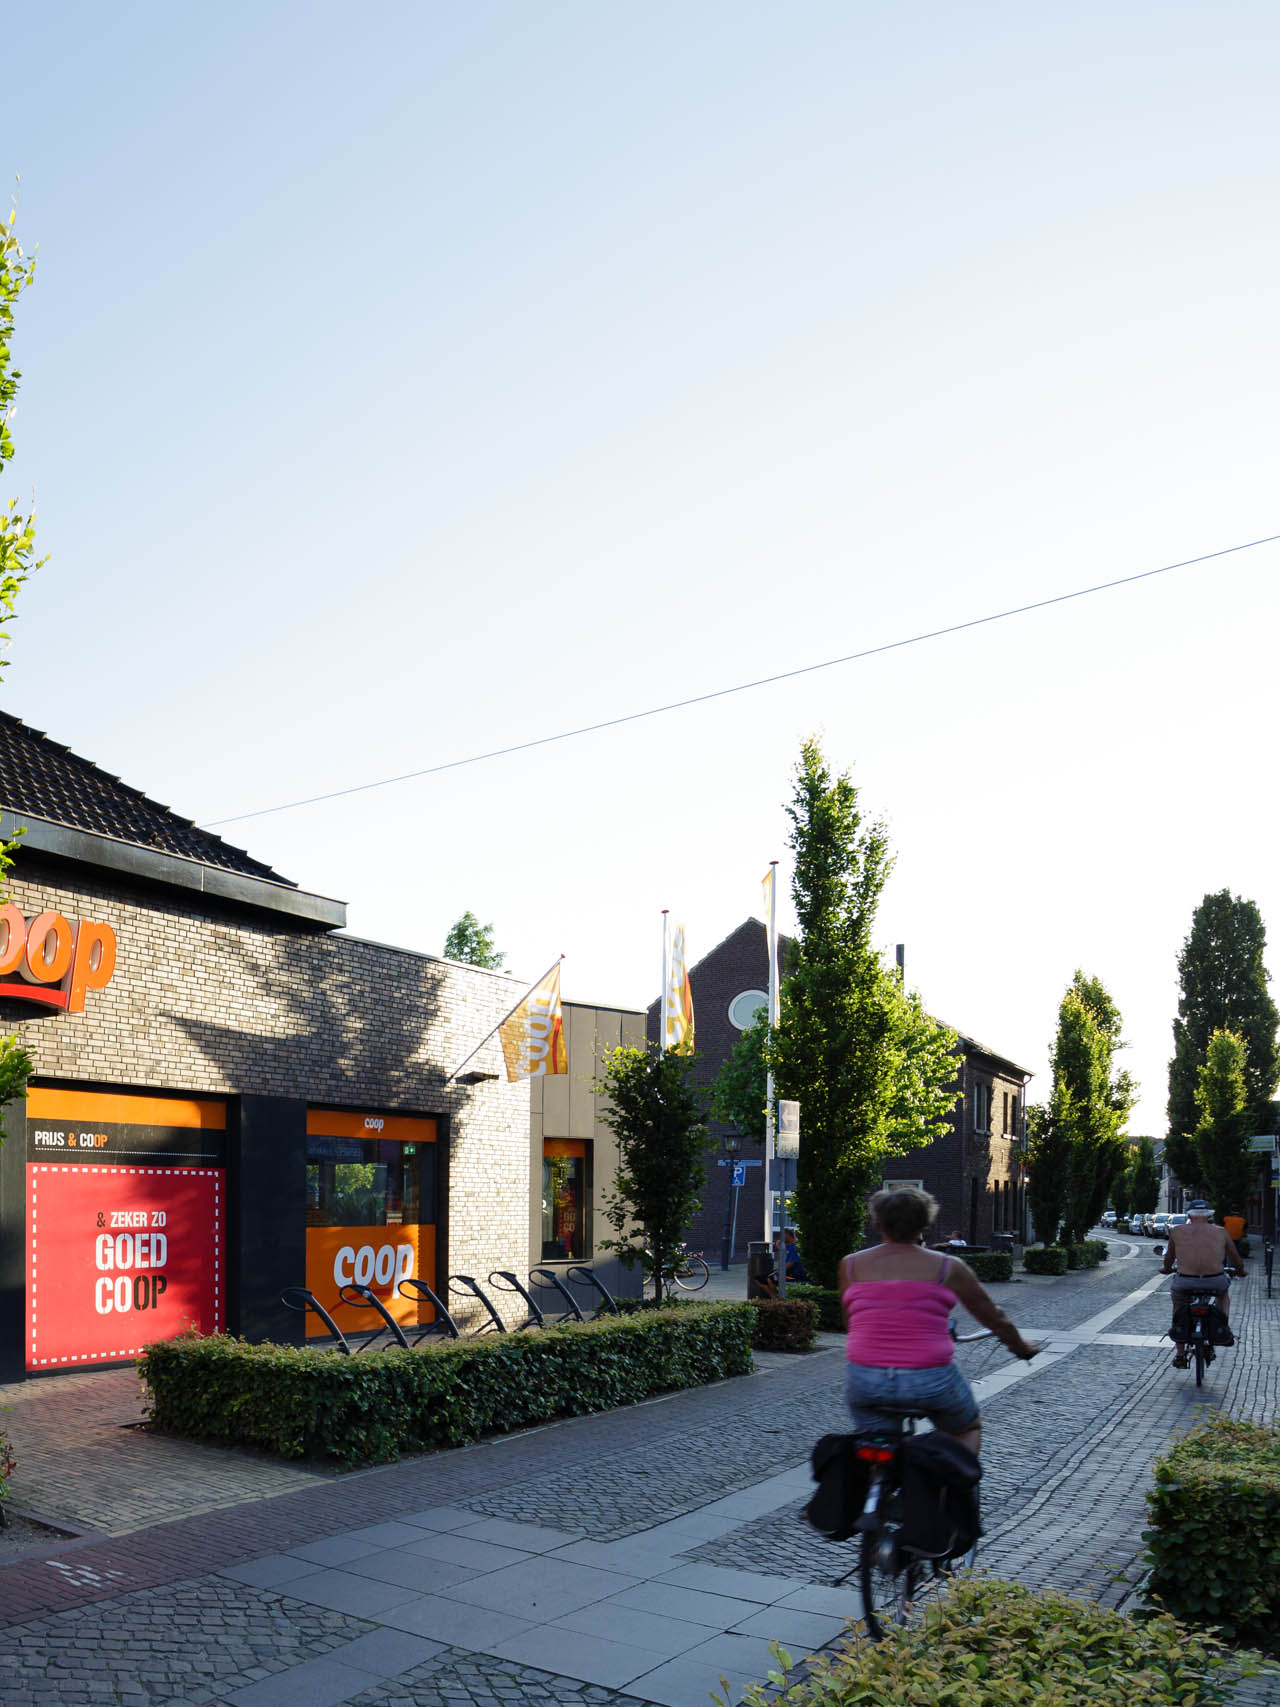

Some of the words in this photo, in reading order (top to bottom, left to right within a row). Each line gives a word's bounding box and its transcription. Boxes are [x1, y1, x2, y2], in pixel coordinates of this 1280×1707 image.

[516, 988, 562, 1078] coop
[364, 1117, 384, 1133] coop
[34, 1131, 65, 1147] PRIJS
[67, 1132, 77, 1147] &
[79, 1133, 108, 1148] COOP
[733, 1167, 743, 1178] P
[96, 1211, 106, 1228] &
[110, 1211, 148, 1228] ZEKER
[151, 1211, 167, 1227] ZO
[95, 1232, 168, 1271] GOED
[333, 1244, 415, 1299] coop
[95, 1275, 168, 1315] COOP
